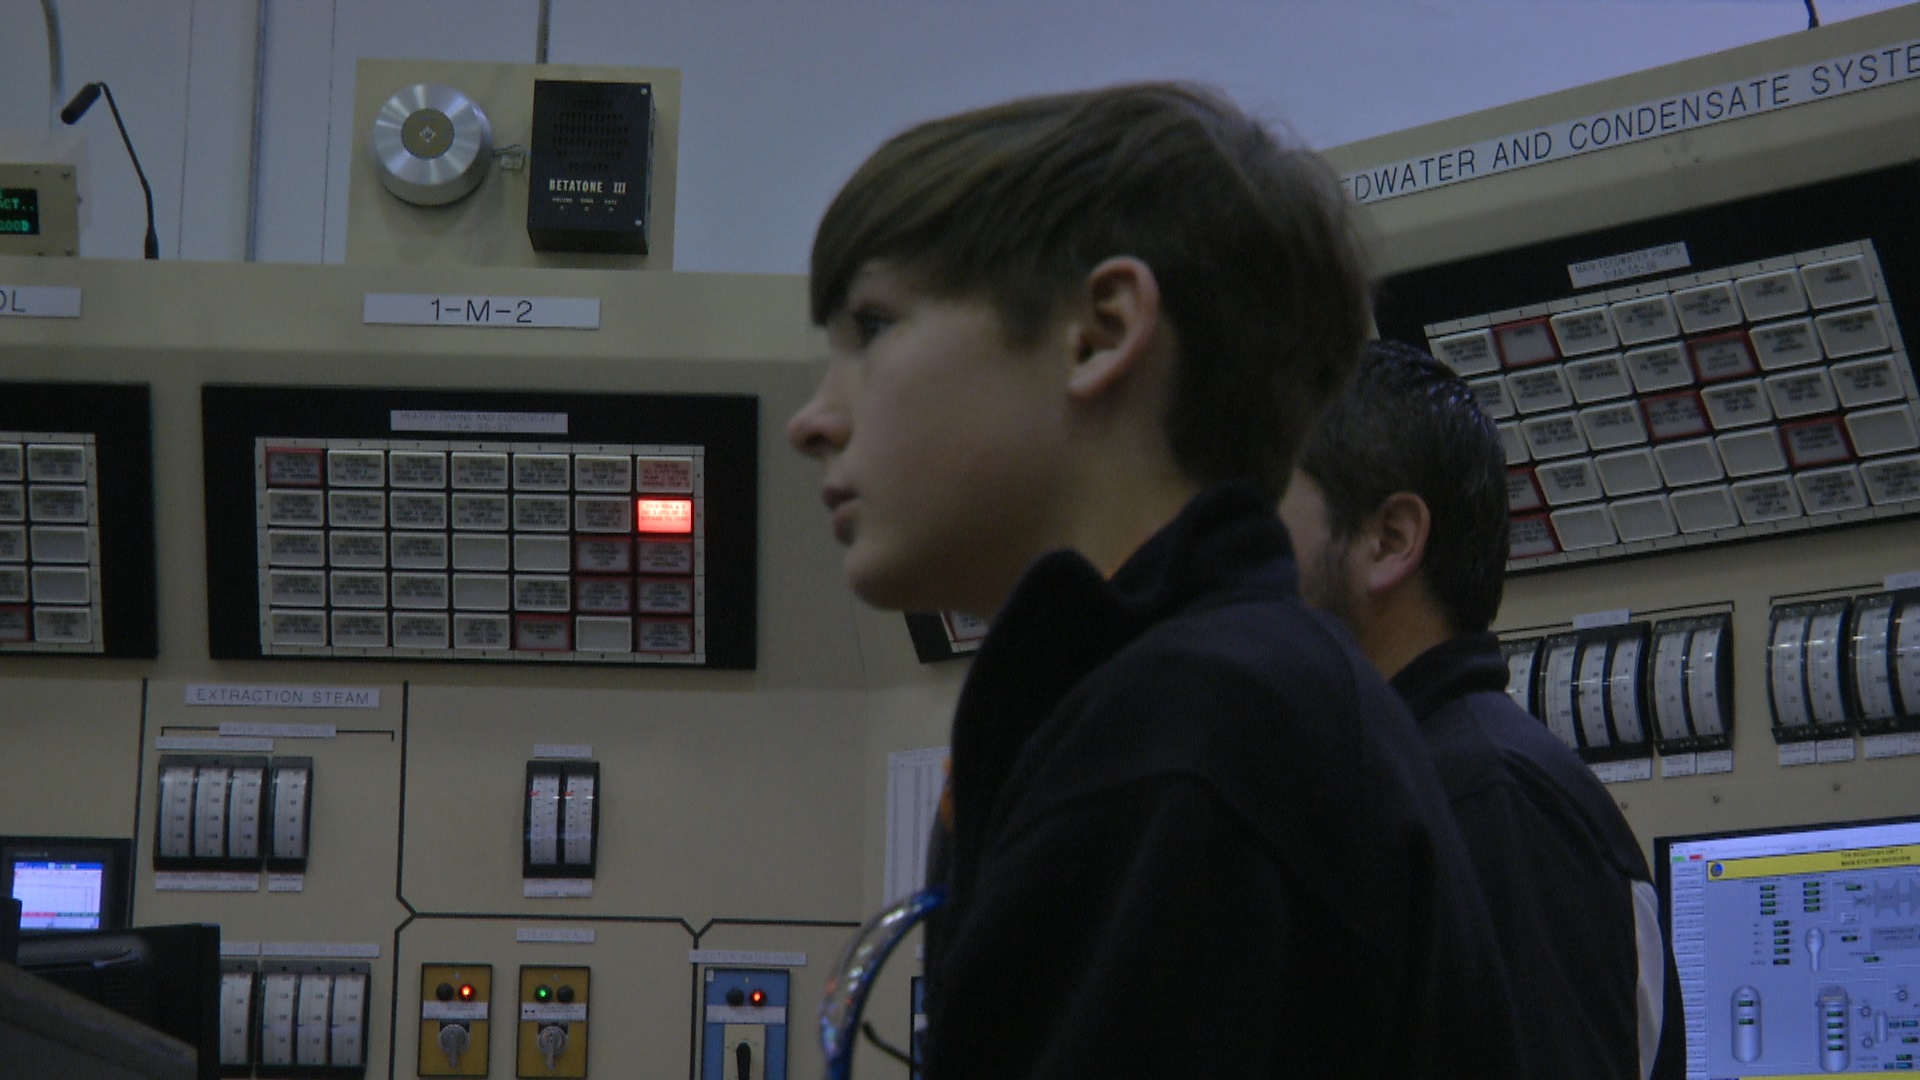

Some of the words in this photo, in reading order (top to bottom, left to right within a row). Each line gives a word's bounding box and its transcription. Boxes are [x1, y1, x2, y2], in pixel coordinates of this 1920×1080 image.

[1341, 149, 1475, 201] DWATER
[1492, 131, 1552, 169] AND
[1569, 74, 1791, 150] CONDENSATE
[549, 178, 603, 193] BETATONE
[431, 298, 533, 323] 1-M-2
[197, 688, 303, 703] EXTRACTION
[312, 690, 370, 705] STEAM
